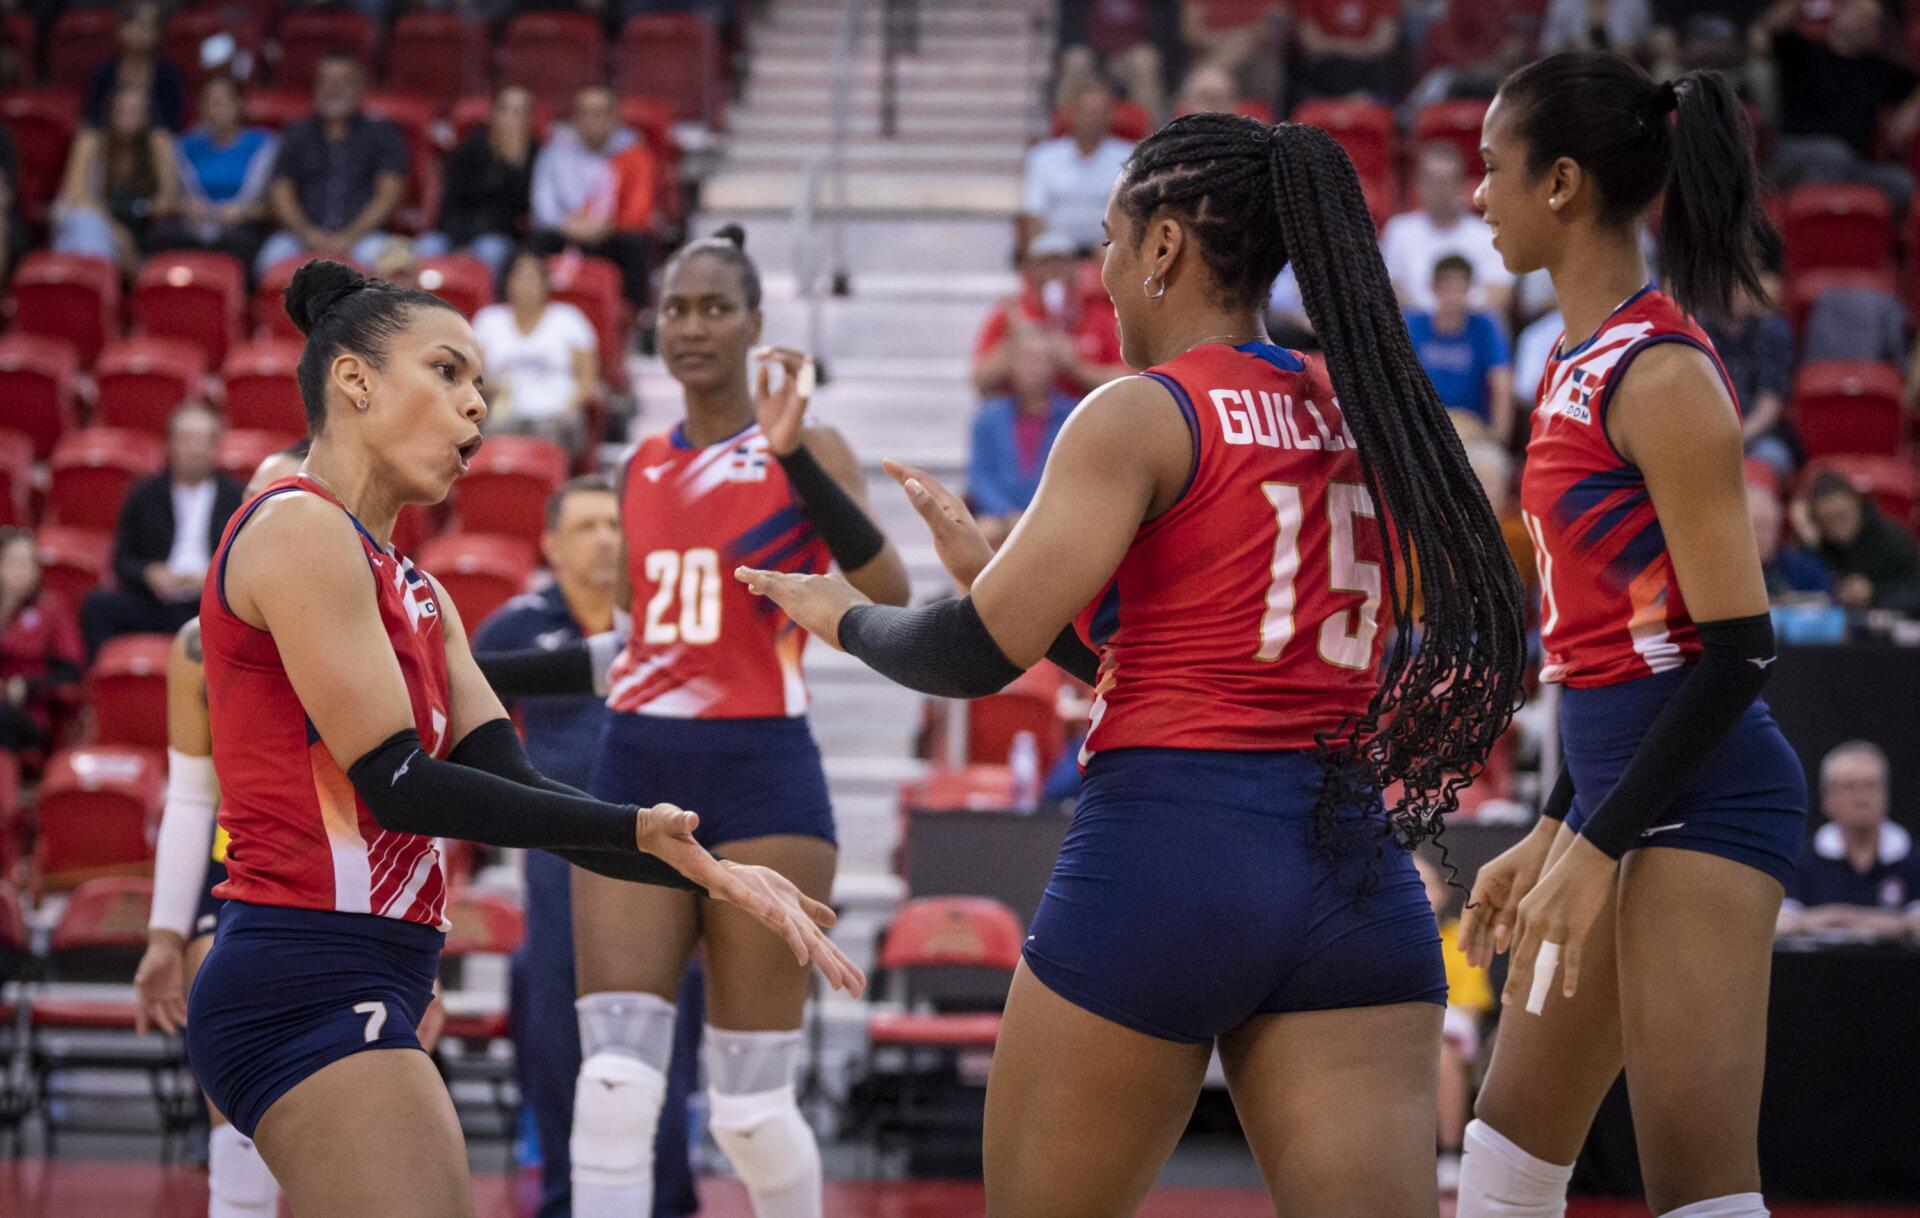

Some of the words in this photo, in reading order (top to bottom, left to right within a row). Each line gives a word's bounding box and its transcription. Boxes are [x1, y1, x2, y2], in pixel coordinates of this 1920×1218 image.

[1566, 405, 1589, 419] DOM
[644, 547, 722, 645] 20
[1252, 479, 1382, 671] 15
[352, 1001, 387, 1042] 7
